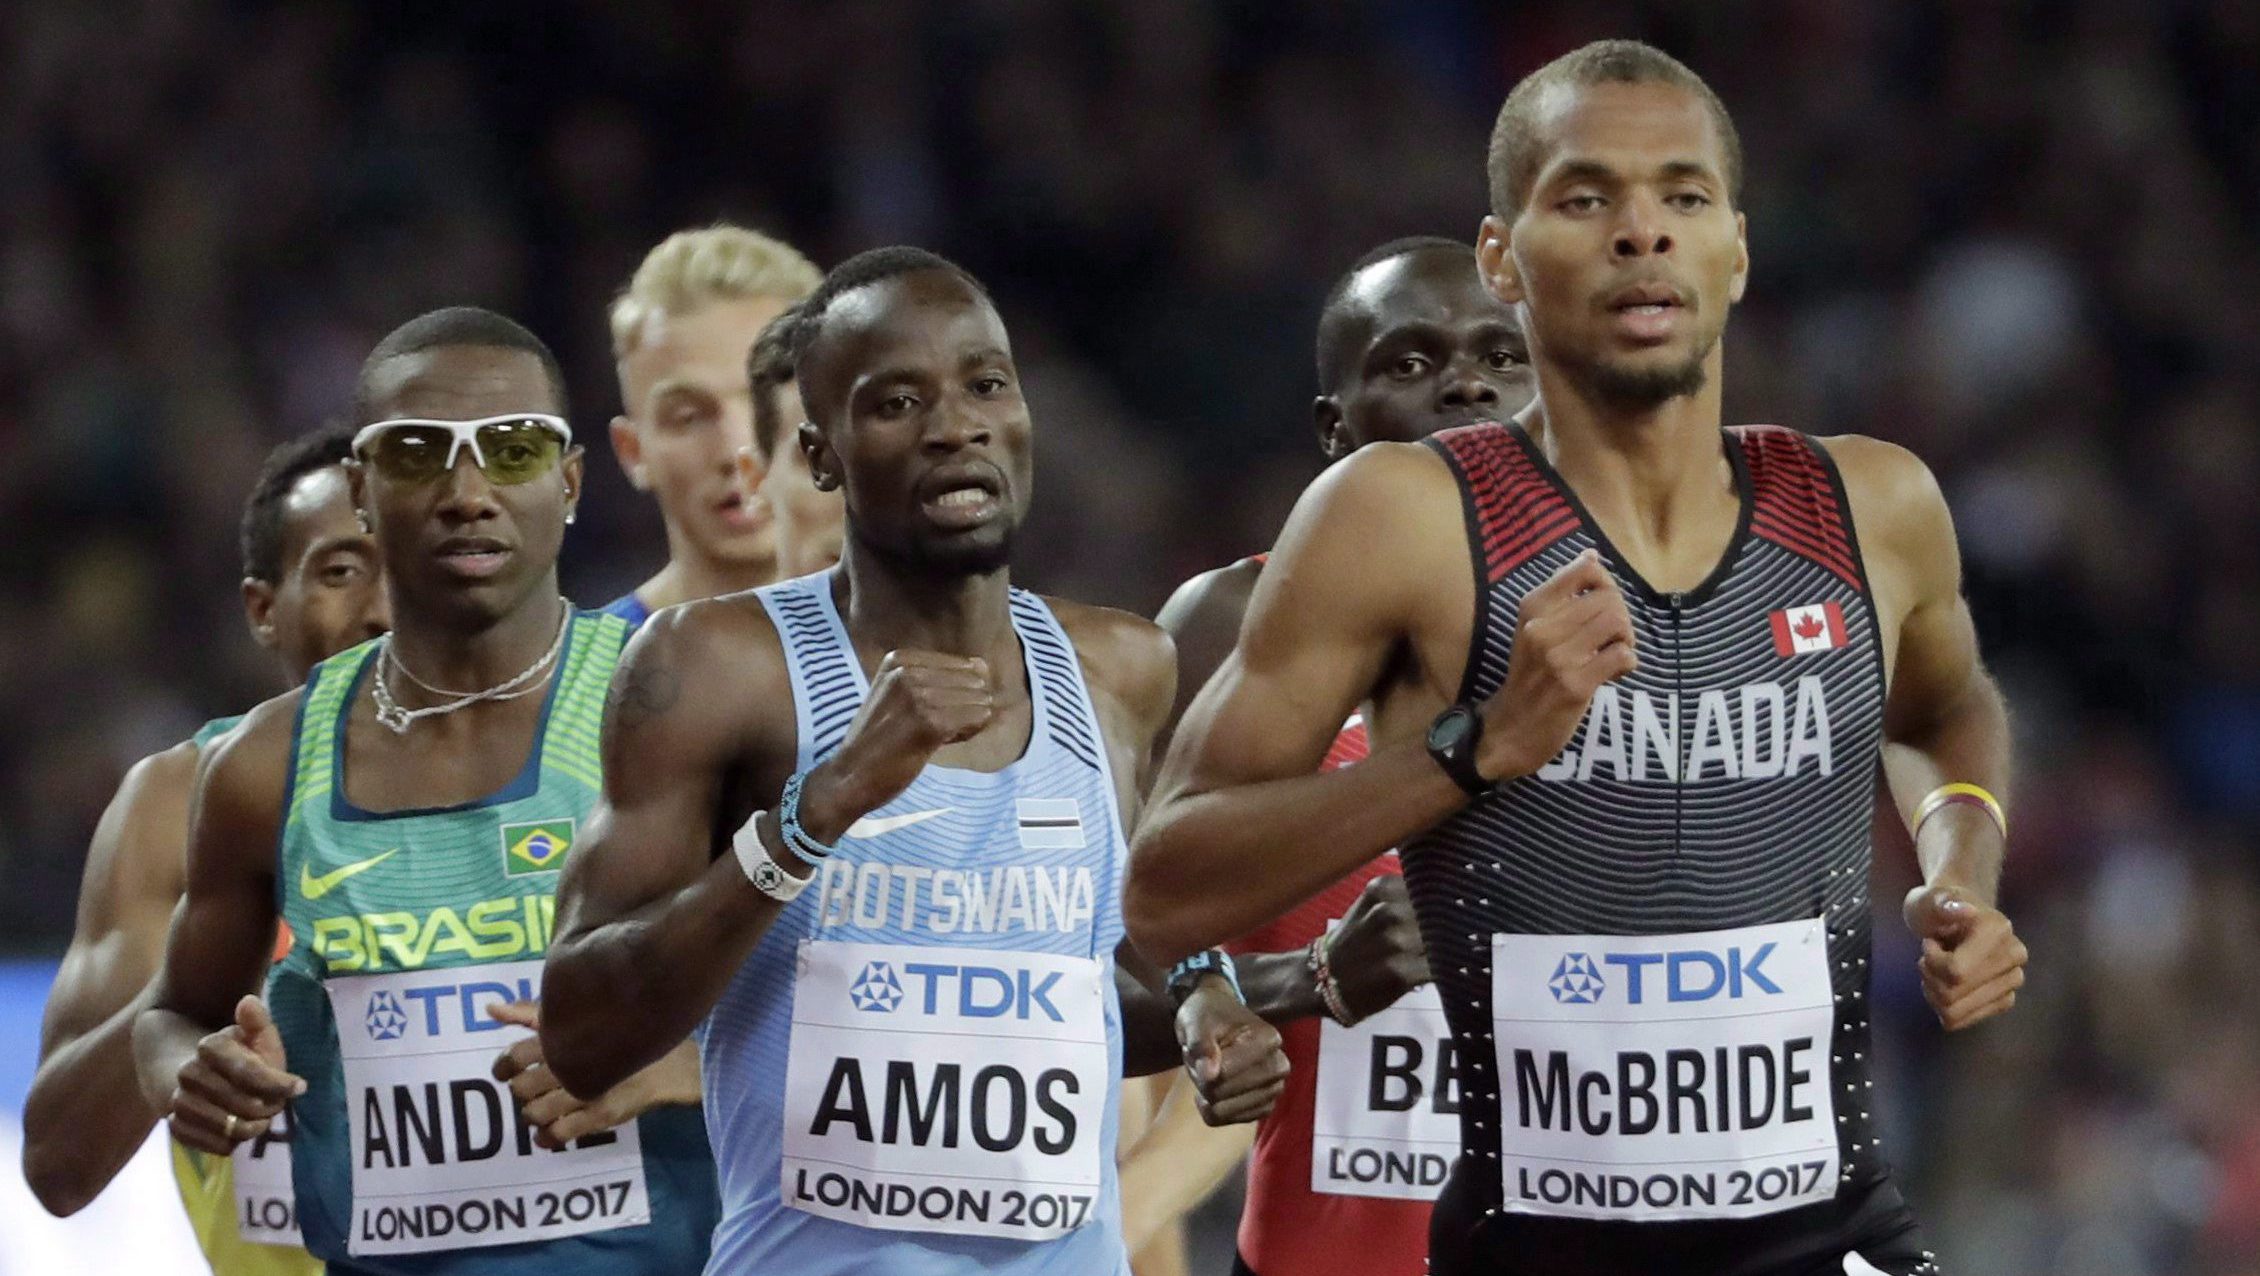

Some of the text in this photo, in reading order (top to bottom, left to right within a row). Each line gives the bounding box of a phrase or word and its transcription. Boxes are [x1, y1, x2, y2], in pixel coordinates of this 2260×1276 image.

[819, 859, 1094, 934] BOTSWANA
[905, 963, 1065, 1022] TDK
[1605, 942, 1784, 1005] TDK
[809, 1056, 1080, 1156] AMOS
[1514, 1037, 1815, 1136] McBRIDE
[363, 1078, 617, 1169] AND
[362, 1180, 634, 1242] LONDON 2017
[796, 1168, 1092, 1229] LONDON 2017
[1519, 1160, 1828, 1208] LONDON 2017
